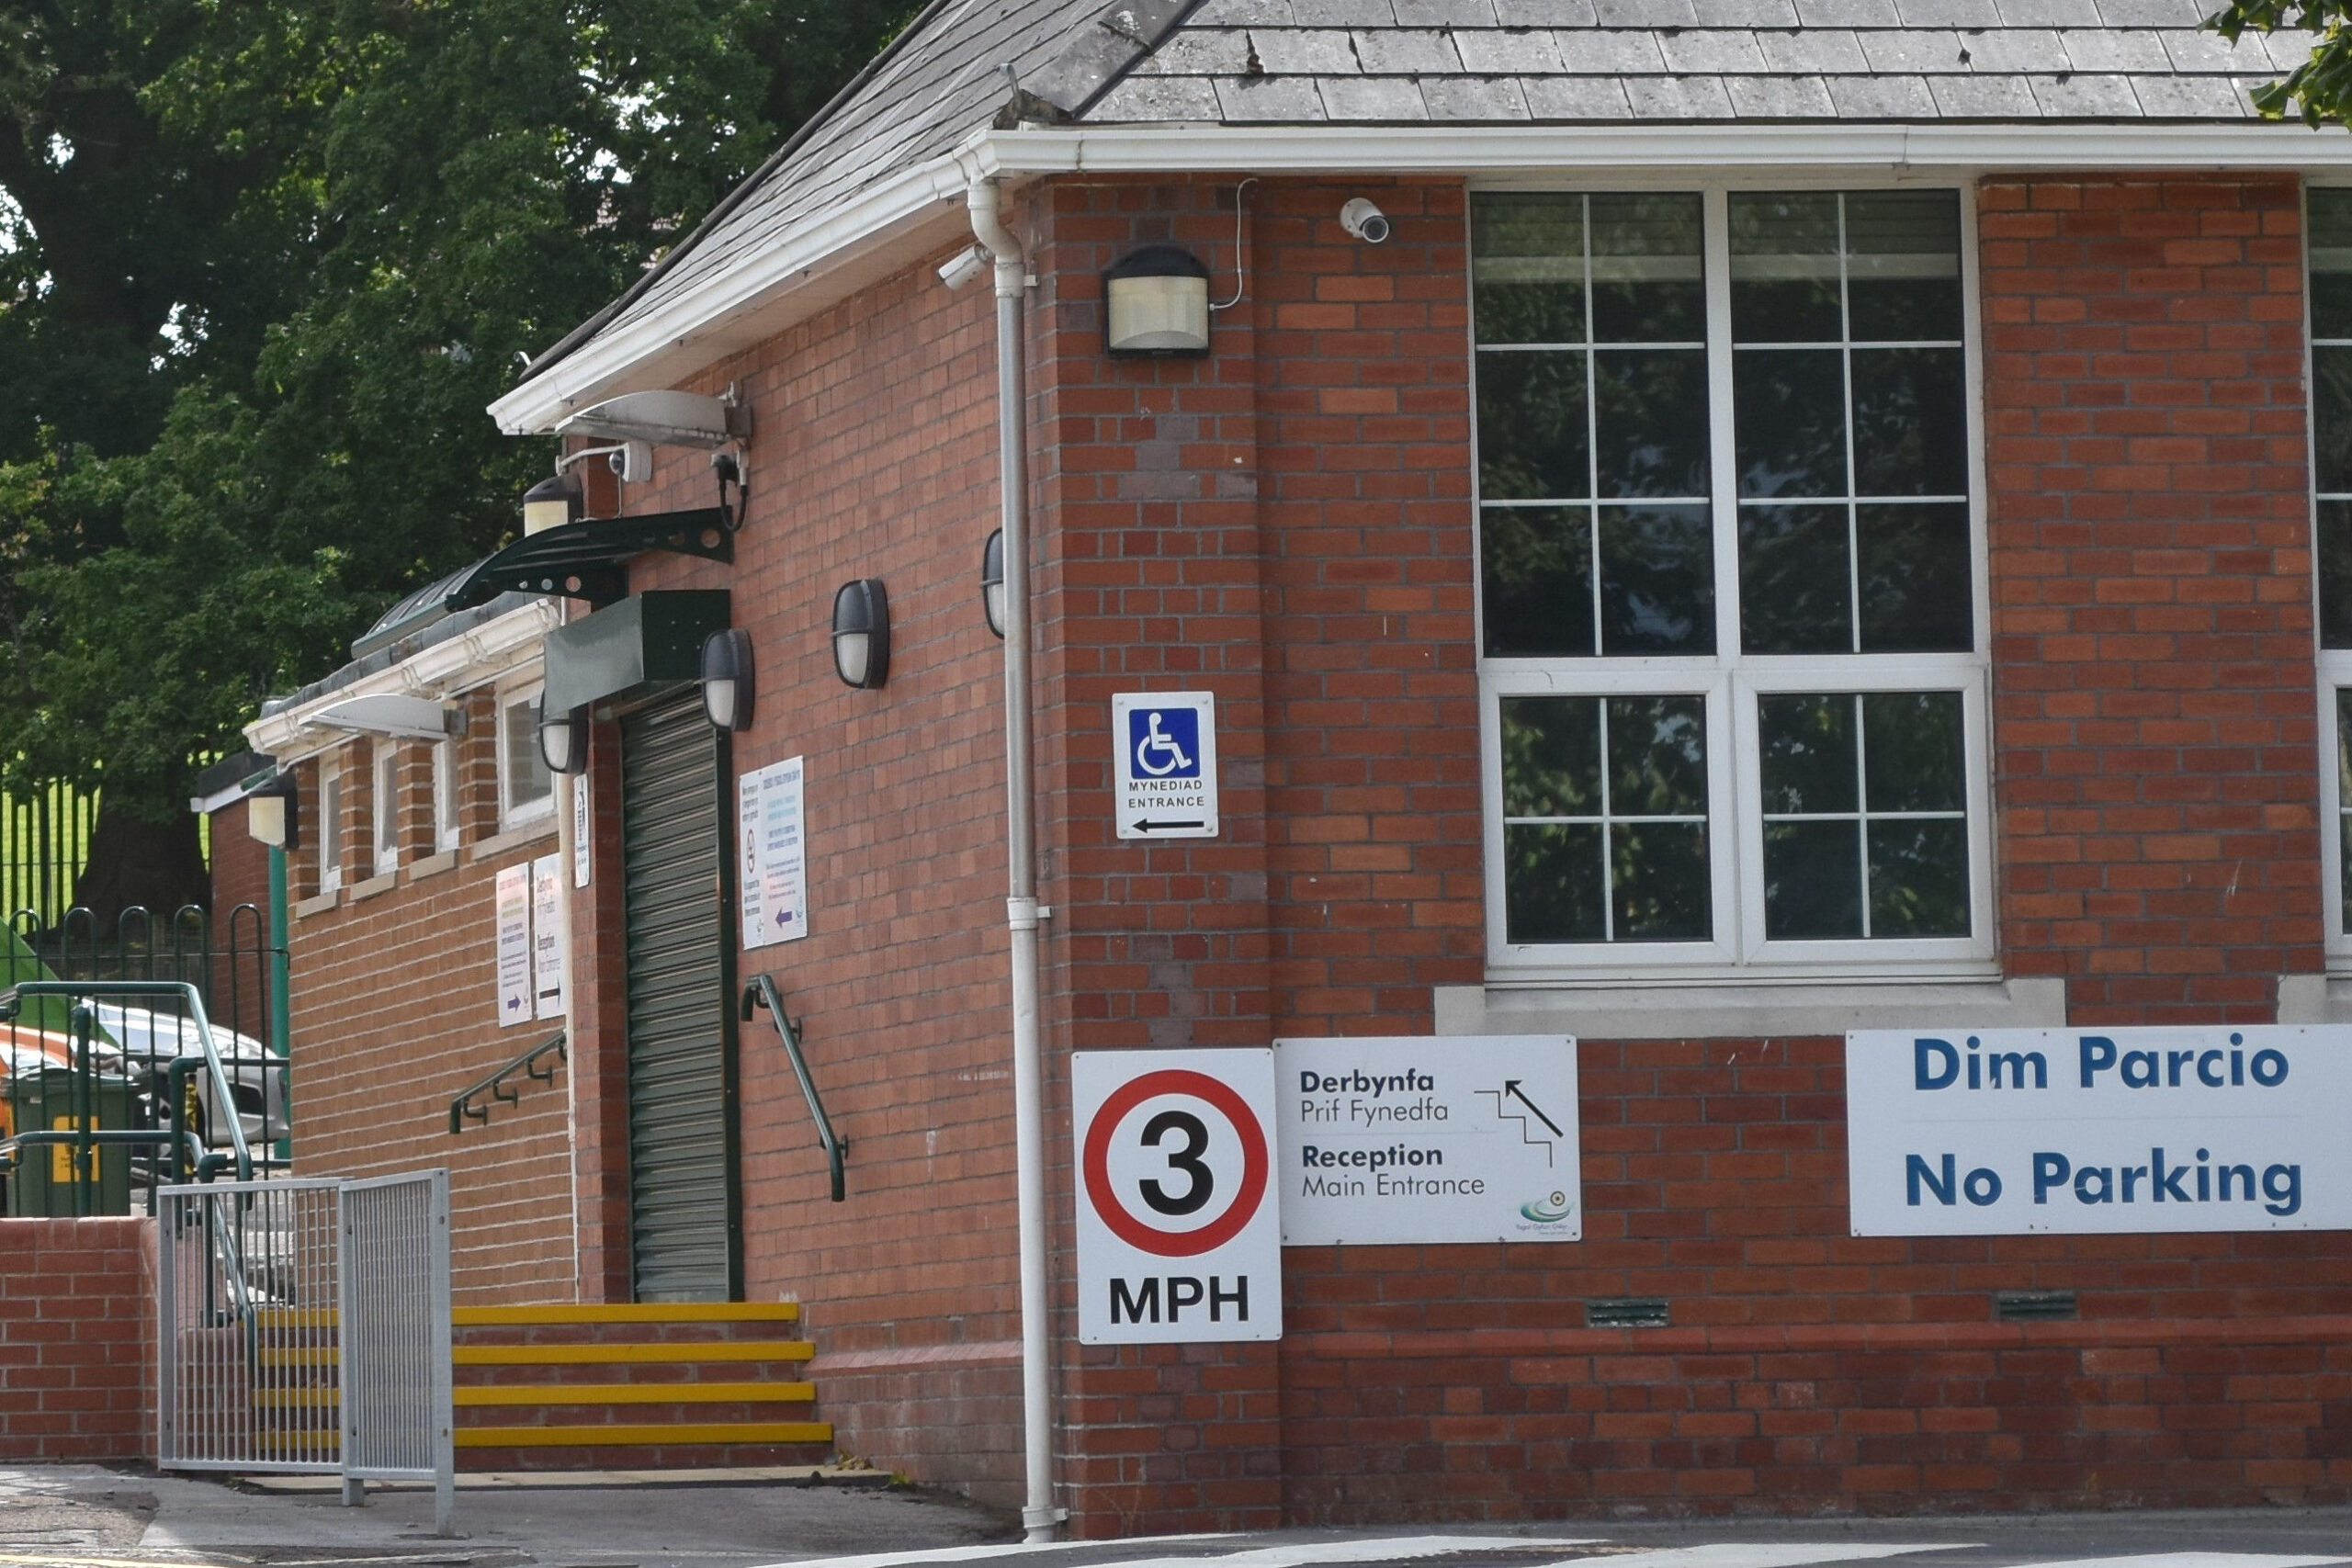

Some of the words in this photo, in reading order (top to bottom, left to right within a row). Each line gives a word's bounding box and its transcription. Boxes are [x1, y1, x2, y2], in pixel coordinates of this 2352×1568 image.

[1128, 779, 1203, 792] MYNEDIAD
[1128, 795, 1204, 809] ENTRANCE
[1914, 1036, 2049, 1090] Dim
[2078, 1032, 2290, 1089] Parcio
[1300, 1068, 1434, 1099] Derbynfa
[1301, 1100, 1340, 1122] Prif
[1350, 1097, 1449, 1128] Fynedfa
[1138, 1110, 1215, 1216] 3
[1302, 1144, 1443, 1172] Reception
[1302, 1174, 1365, 1198] Main
[1376, 1173, 1486, 1196] Entrance
[1905, 1154, 2003, 1207] No
[2032, 1147, 2302, 1217] Parking
[1109, 1275, 1250, 1325] MPH
